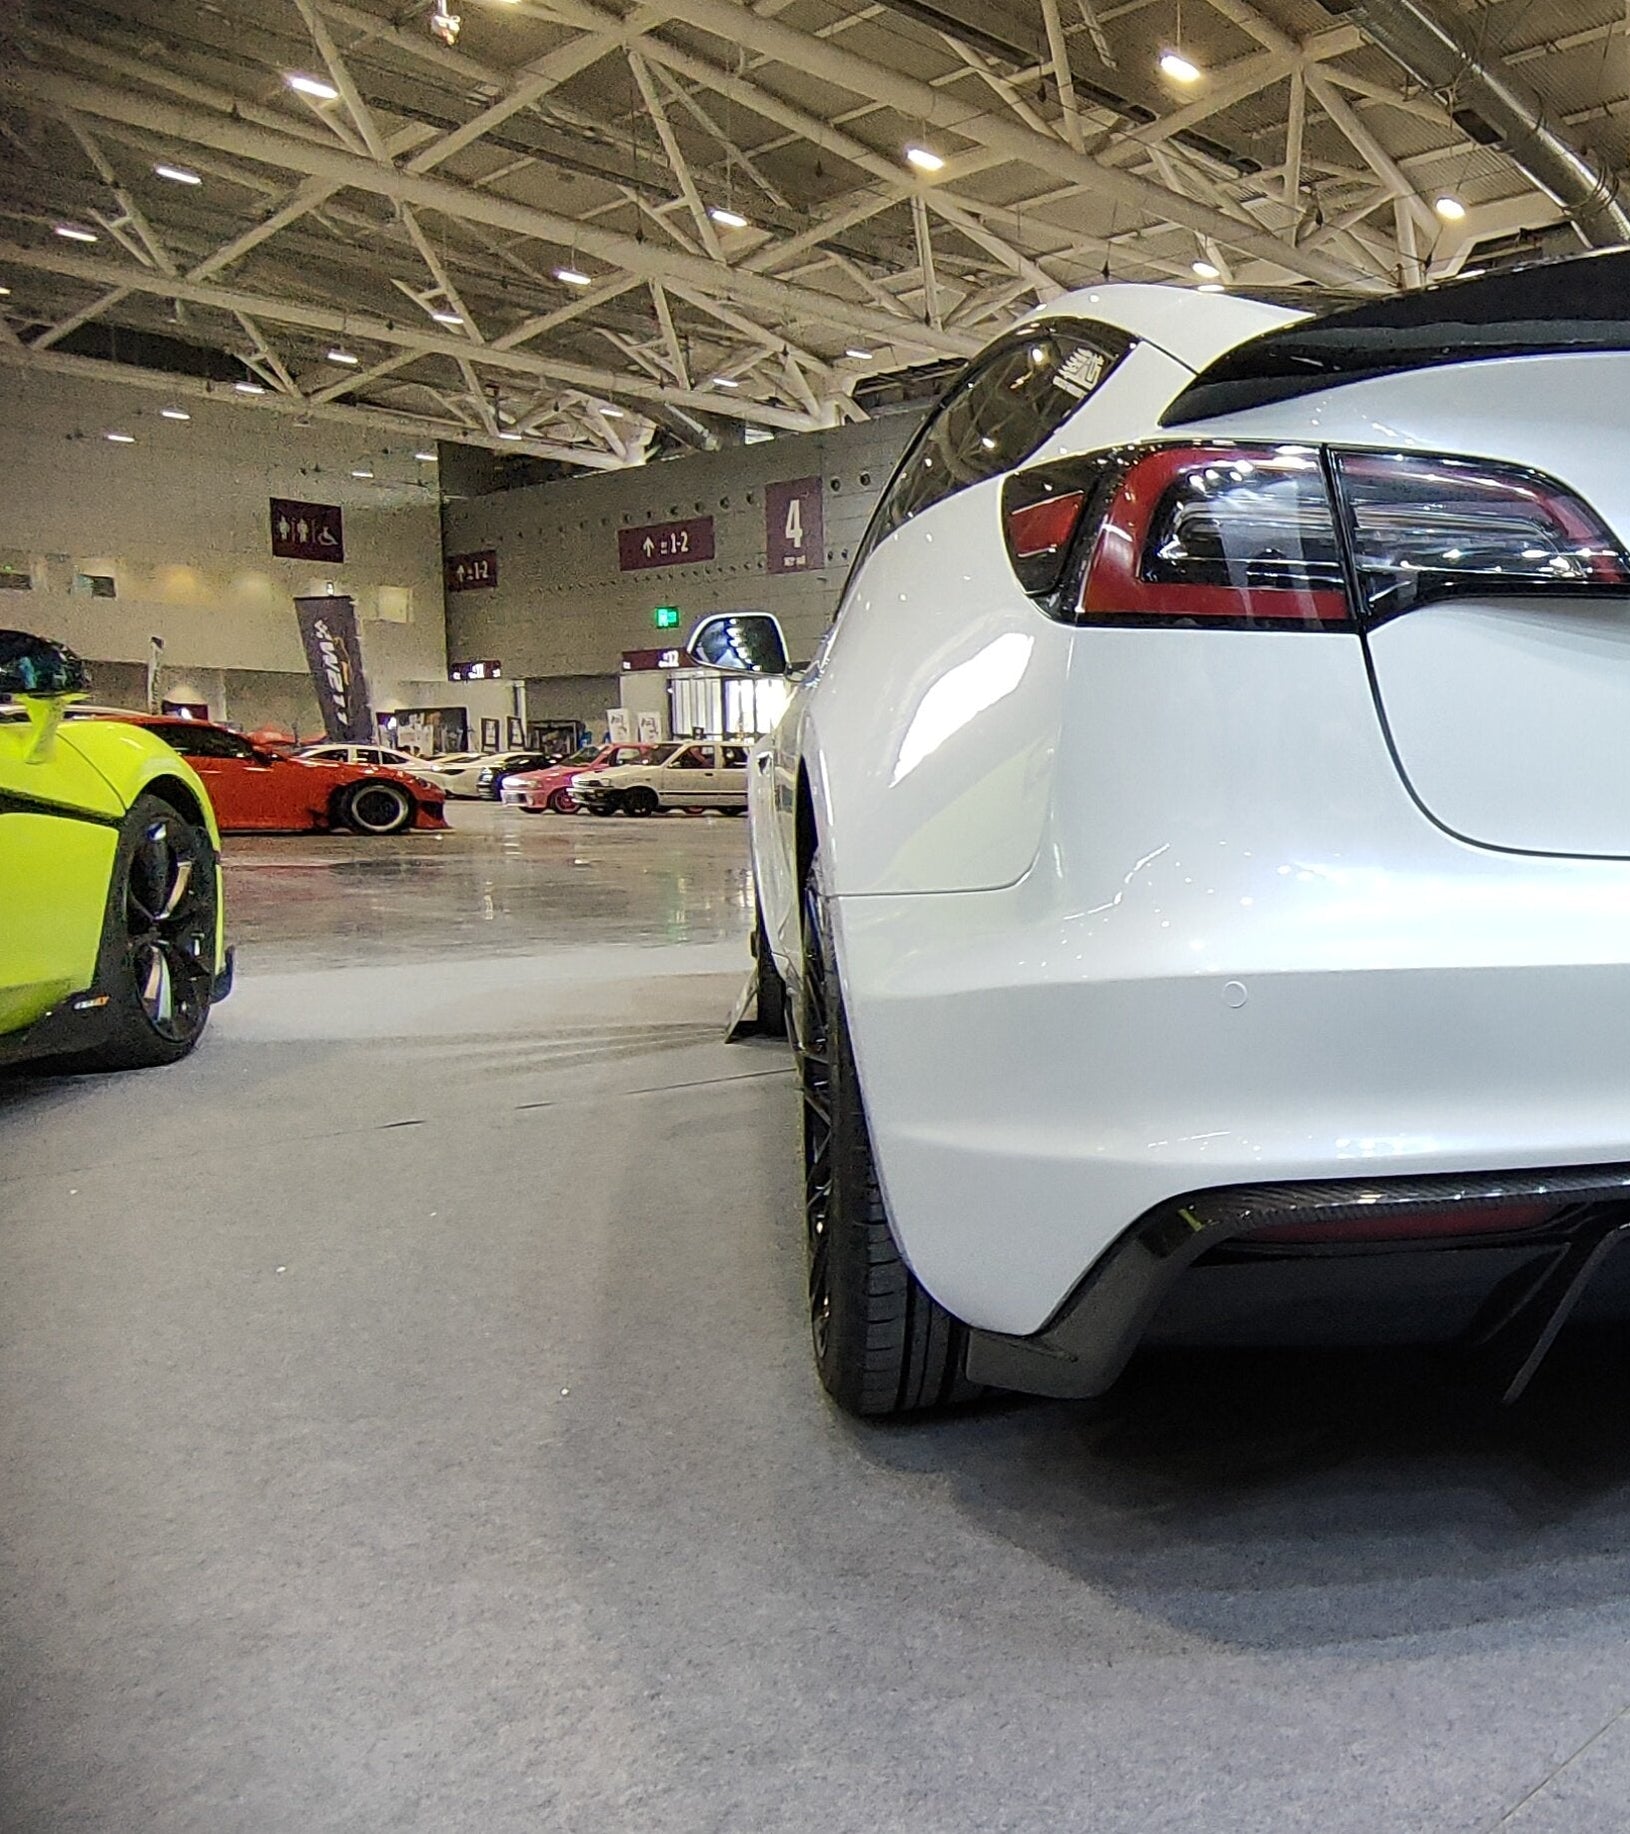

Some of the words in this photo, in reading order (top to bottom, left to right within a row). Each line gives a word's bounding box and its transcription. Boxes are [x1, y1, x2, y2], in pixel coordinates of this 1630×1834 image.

[785, 499, 803, 548] 4
[670, 531, 689, 553] 1-2
[474, 560, 489, 579] 1-2
